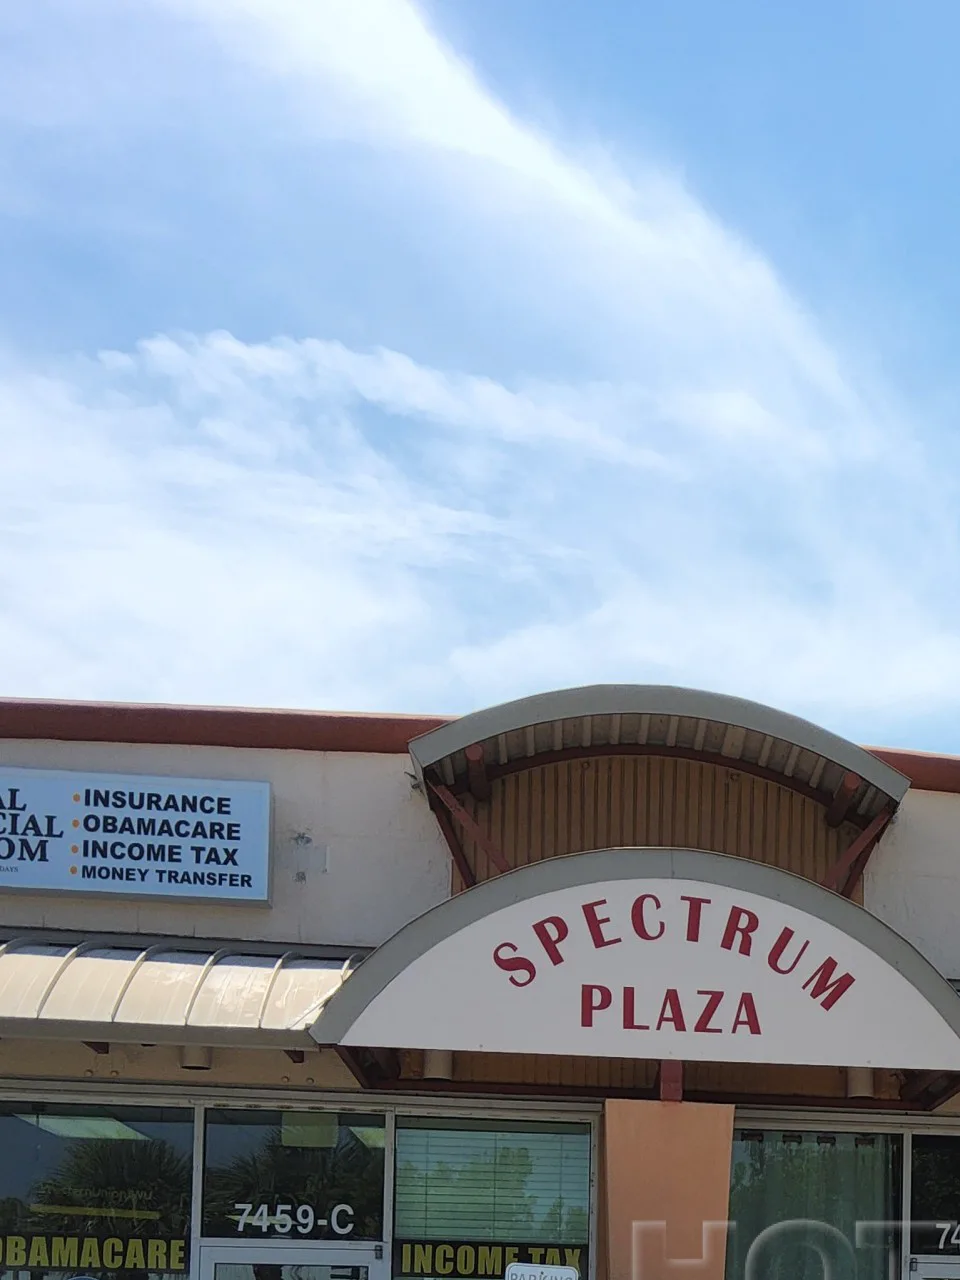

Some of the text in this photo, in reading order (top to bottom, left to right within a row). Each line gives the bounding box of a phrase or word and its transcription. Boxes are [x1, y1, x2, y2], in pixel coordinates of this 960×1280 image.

[84, 789, 231, 815] INSURANCE
[83, 814, 241, 841] OBAMACARE
[82, 840, 239, 866] INCOME TAX
[81, 865, 253, 888] MONEY TRANSFER
[493, 893, 856, 1011] SPECTRUM
[580, 983, 762, 1035] PLAZA
[234, 1203, 354, 1235] 7459-C
[0, 1235, 185, 1269] BAMACARE
[401, 1243, 519, 1275] INCOME
